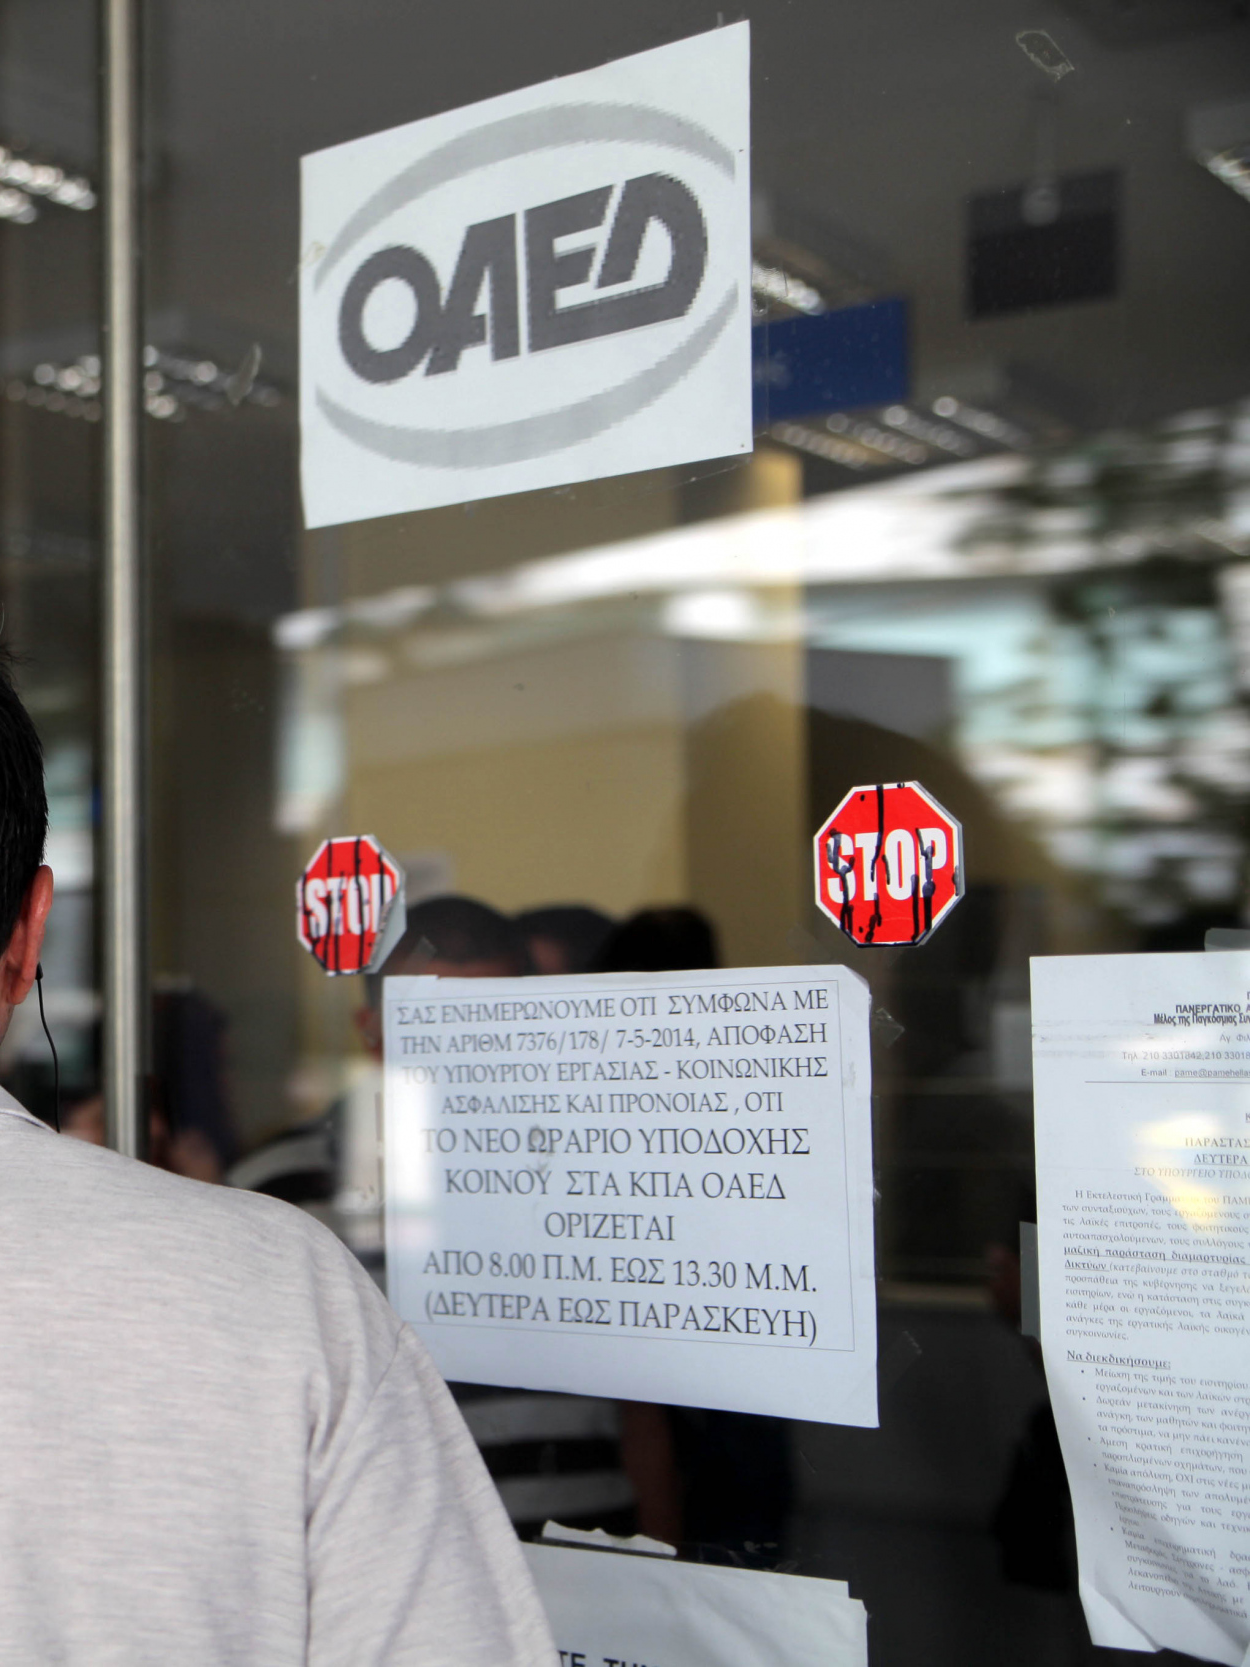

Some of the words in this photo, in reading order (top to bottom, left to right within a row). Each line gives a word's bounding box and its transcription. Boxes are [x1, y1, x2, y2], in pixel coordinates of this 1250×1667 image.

[827, 827, 947, 903] STOP
[397, 1005, 436, 1026] ΣΑΣ
[441, 997, 616, 1024] ΕΝΗΜΕΡΩΝΟΥΜΕ
[620, 996, 657, 1017] ΟΤΙ
[668, 991, 788, 1015] ΣΥΜΦΩΝΑ
[793, 988, 829, 1010] ΜΕ
[1175, 1004, 1241, 1014] ΠΑΝΕΡΓΑΤΙΚΟ
[1153, 1013, 1176, 1027] Μέλος
[1178, 1016, 1190, 1027] της
[400, 1034, 441, 1055] ΤΗΝ
[446, 1032, 512, 1053] ΑΡΙΘΜ
[616, 1027, 701, 1049] 7-5-2014,
[706, 1022, 828, 1046] ΑΠΟΦΑΣΗ
[1143, 1051, 1159, 1060] 210
[401, 1065, 440, 1085] ΤΟΥ
[443, 1063, 551, 1084] ΥΠΟΥΡΓΟΥ
[556, 1060, 659, 1081] ΕΡΓΑΣΙΑΣ
[676, 1056, 829, 1079] ΚΟΙΝΩΝΙΚΗΣ
[442, 1094, 561, 1114] ΑΣΦΑΛΙΣΗΣ
[566, 1094, 604, 1114] ΚΑΙ
[745, 1091, 784, 1113] ΟΤΙ
[421, 1128, 457, 1153] ΤΟ
[463, 1128, 520, 1153] ΝΕΟ
[527, 1127, 631, 1154] ΩΡΑΡΙΟ
[638, 1128, 810, 1155] ΥΠΟΔΟΧΗΣ
[1193, 1153, 1248, 1165] ΔΕΥΤΕΡΑ
[1134, 1167, 1155, 1176] ΣΤΟ
[445, 1169, 551, 1195] ΚΟΙΝΟΥ
[566, 1170, 622, 1196] ΣΤΑ
[629, 1171, 694, 1198] ΚΠΑ
[701, 1171, 786, 1200] ΟΑΕΔ
[1075, 1190, 1083, 1198] Η
[1152, 1208, 1171, 1216] τους
[544, 1212, 676, 1241] ΟΡΙΖΕΤΑΙ
[1167, 1223, 1187, 1231] τους
[1170, 1238, 1190, 1246] τους
[422, 1250, 483, 1276] ΑΠΟ
[489, 1252, 536, 1279] 8.00
[542, 1254, 602, 1282] Π.Μ.
[610, 1256, 666, 1285] ΕΩΣ
[673, 1260, 737, 1288] 13.30
[745, 1262, 817, 1293] Μ.Μ.
[1181, 1268, 1198, 1276] στο
[425, 1291, 551, 1323] (ΔΕΥΤΕΡΑ
[558, 1297, 611, 1325] ΕΩΣ
[618, 1300, 817, 1347] ΠΑΡΑΣΚΕΥΗ)
[1067, 1350, 1083, 1361] Να
